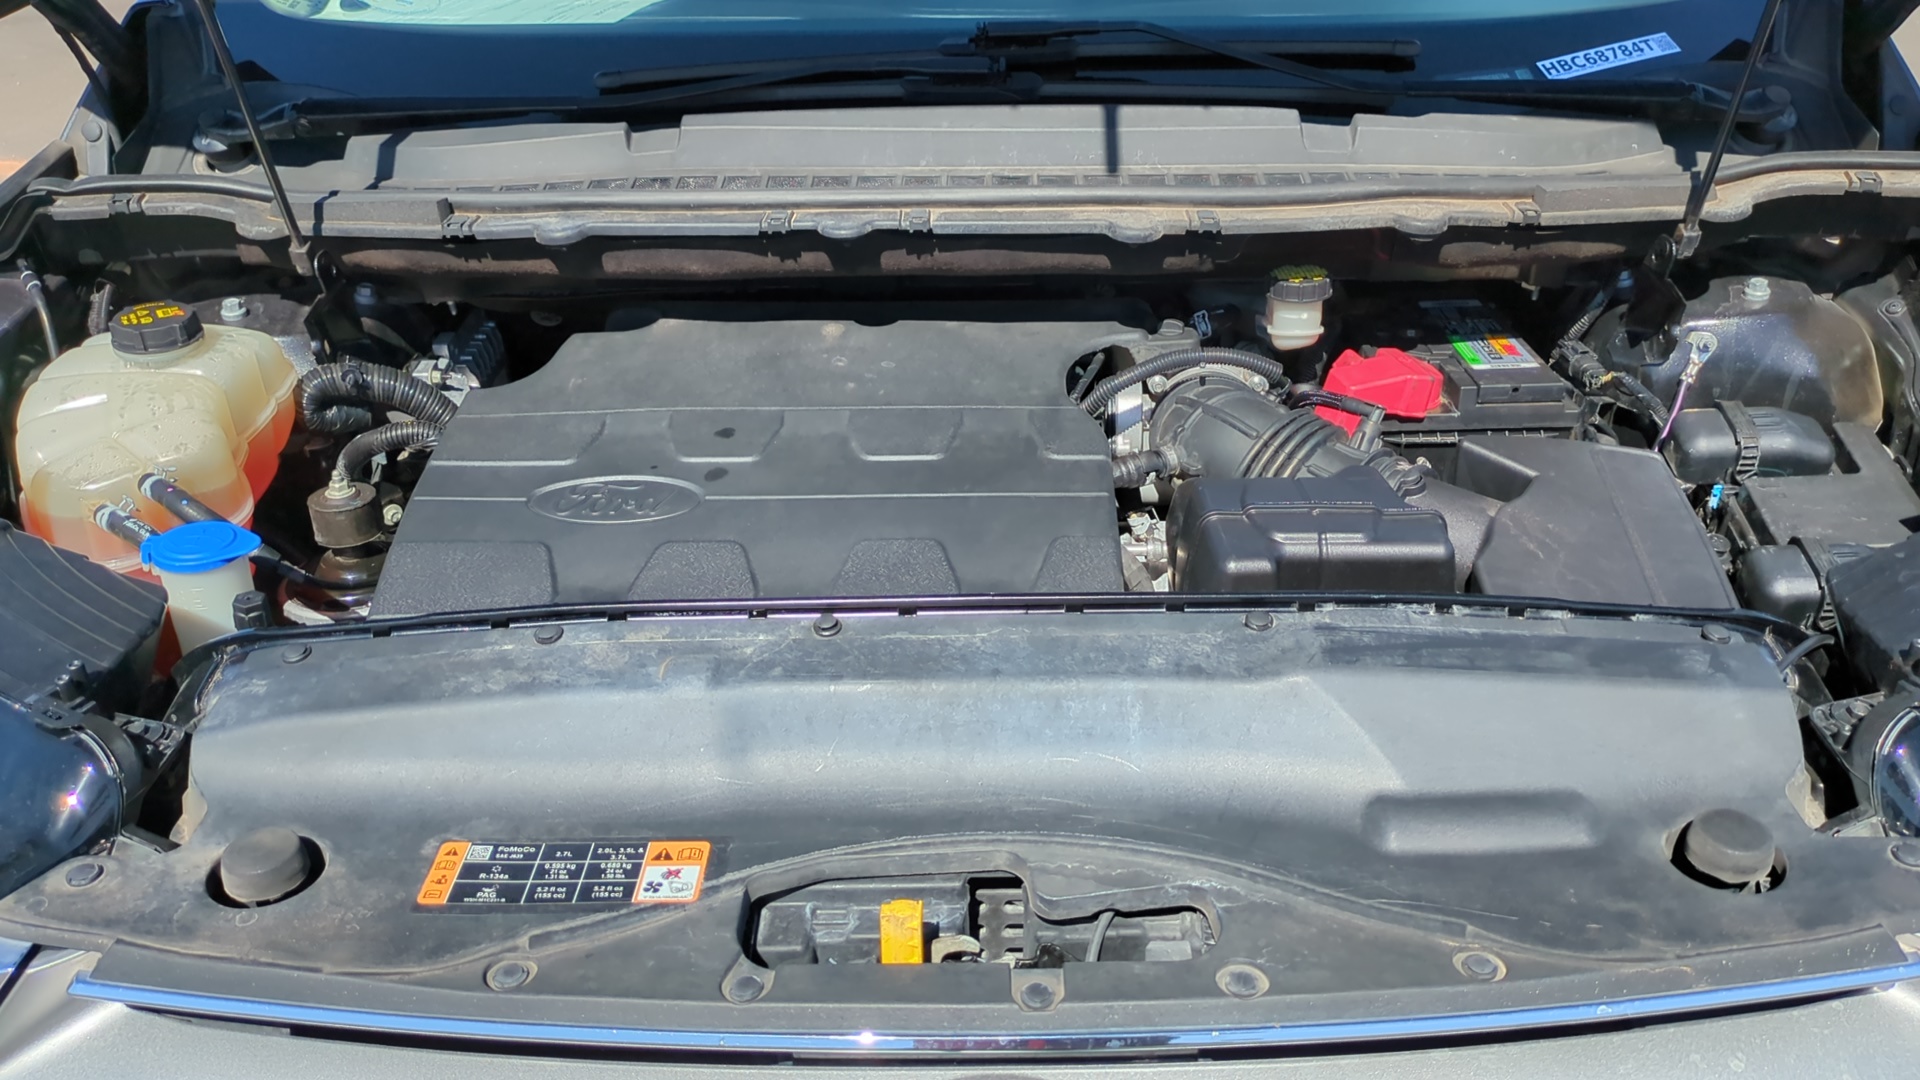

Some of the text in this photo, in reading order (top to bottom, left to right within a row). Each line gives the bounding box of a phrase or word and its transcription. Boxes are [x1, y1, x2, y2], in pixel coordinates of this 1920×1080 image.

[1541, 39, 1656, 76] HBC68784T
[553, 483, 678, 516] Ford
[622, 862, 632, 870] kg
